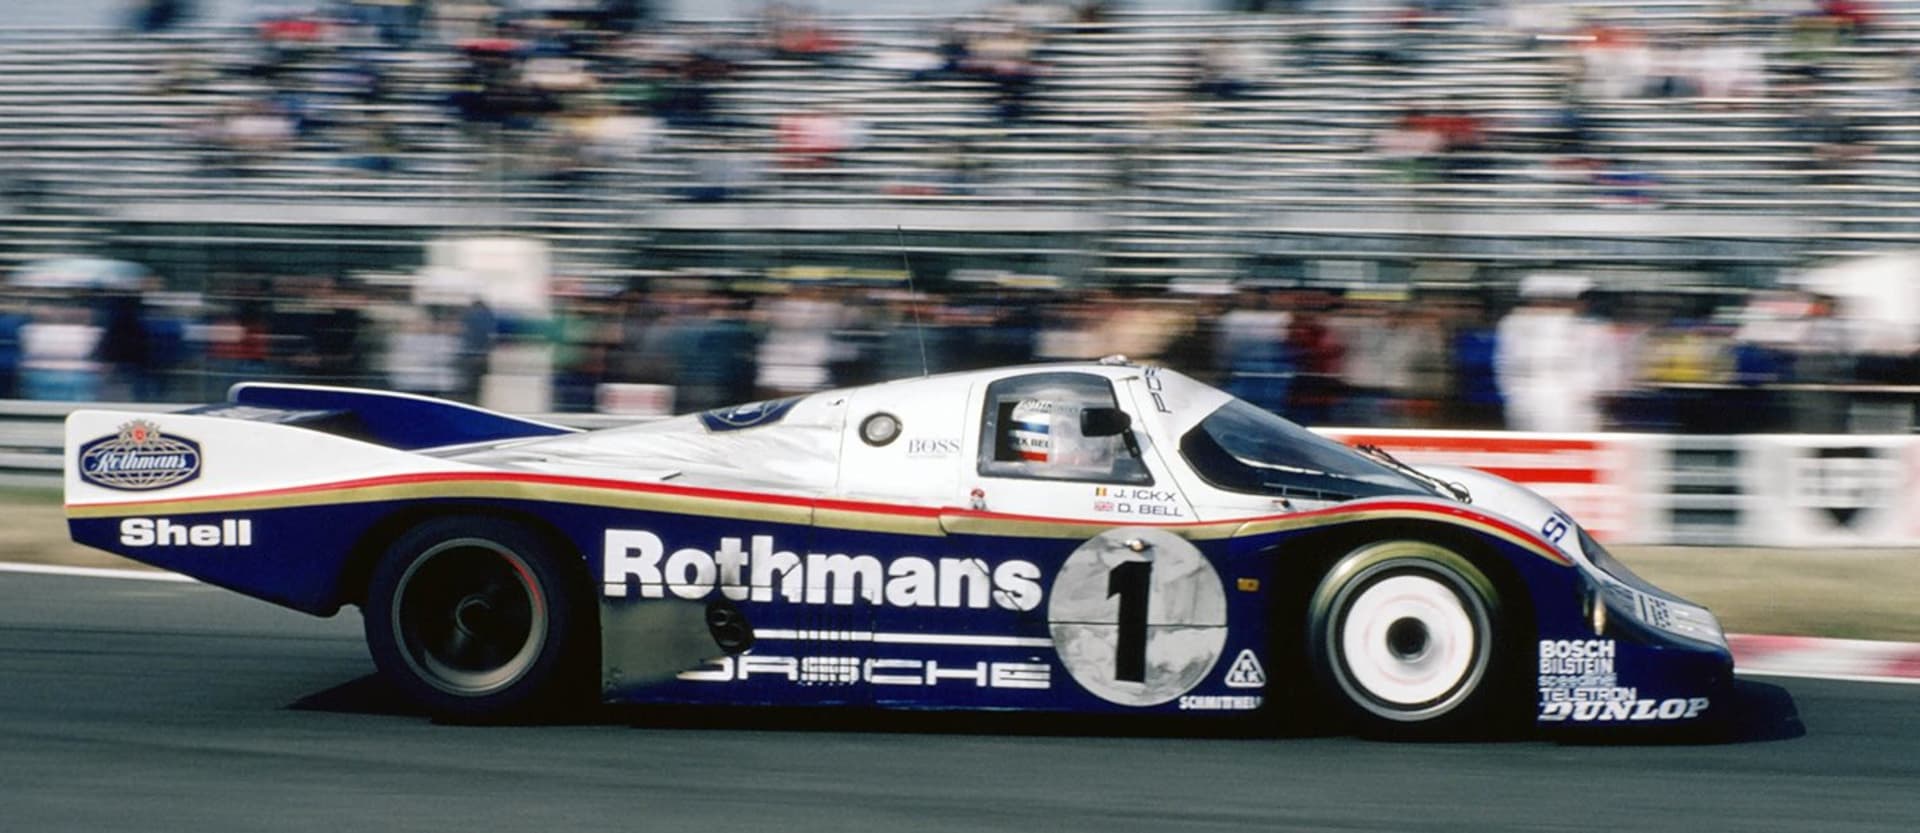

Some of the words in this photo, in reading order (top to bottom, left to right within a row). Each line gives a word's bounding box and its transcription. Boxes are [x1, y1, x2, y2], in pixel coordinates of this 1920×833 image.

[908, 439, 960, 454] BOSS
[90, 450, 188, 473] Rothmans
[1113, 489, 1127, 498] J.
[1132, 489, 1176, 502] ICKX
[1117, 503, 1134, 513] D.
[1139, 504, 1184, 517] BELL
[120, 518, 252, 547] Shell
[604, 528, 1043, 611] Rothmans
[1106, 560, 1153, 684] 1
[1539, 640, 1615, 658] BOSCH
[675, 652, 1051, 689] ORSCHE
[1539, 658, 1614, 674] BILSTEIN
[1538, 687, 1637, 701] TELETRON
[1537, 698, 1710, 721] DUNLOP
